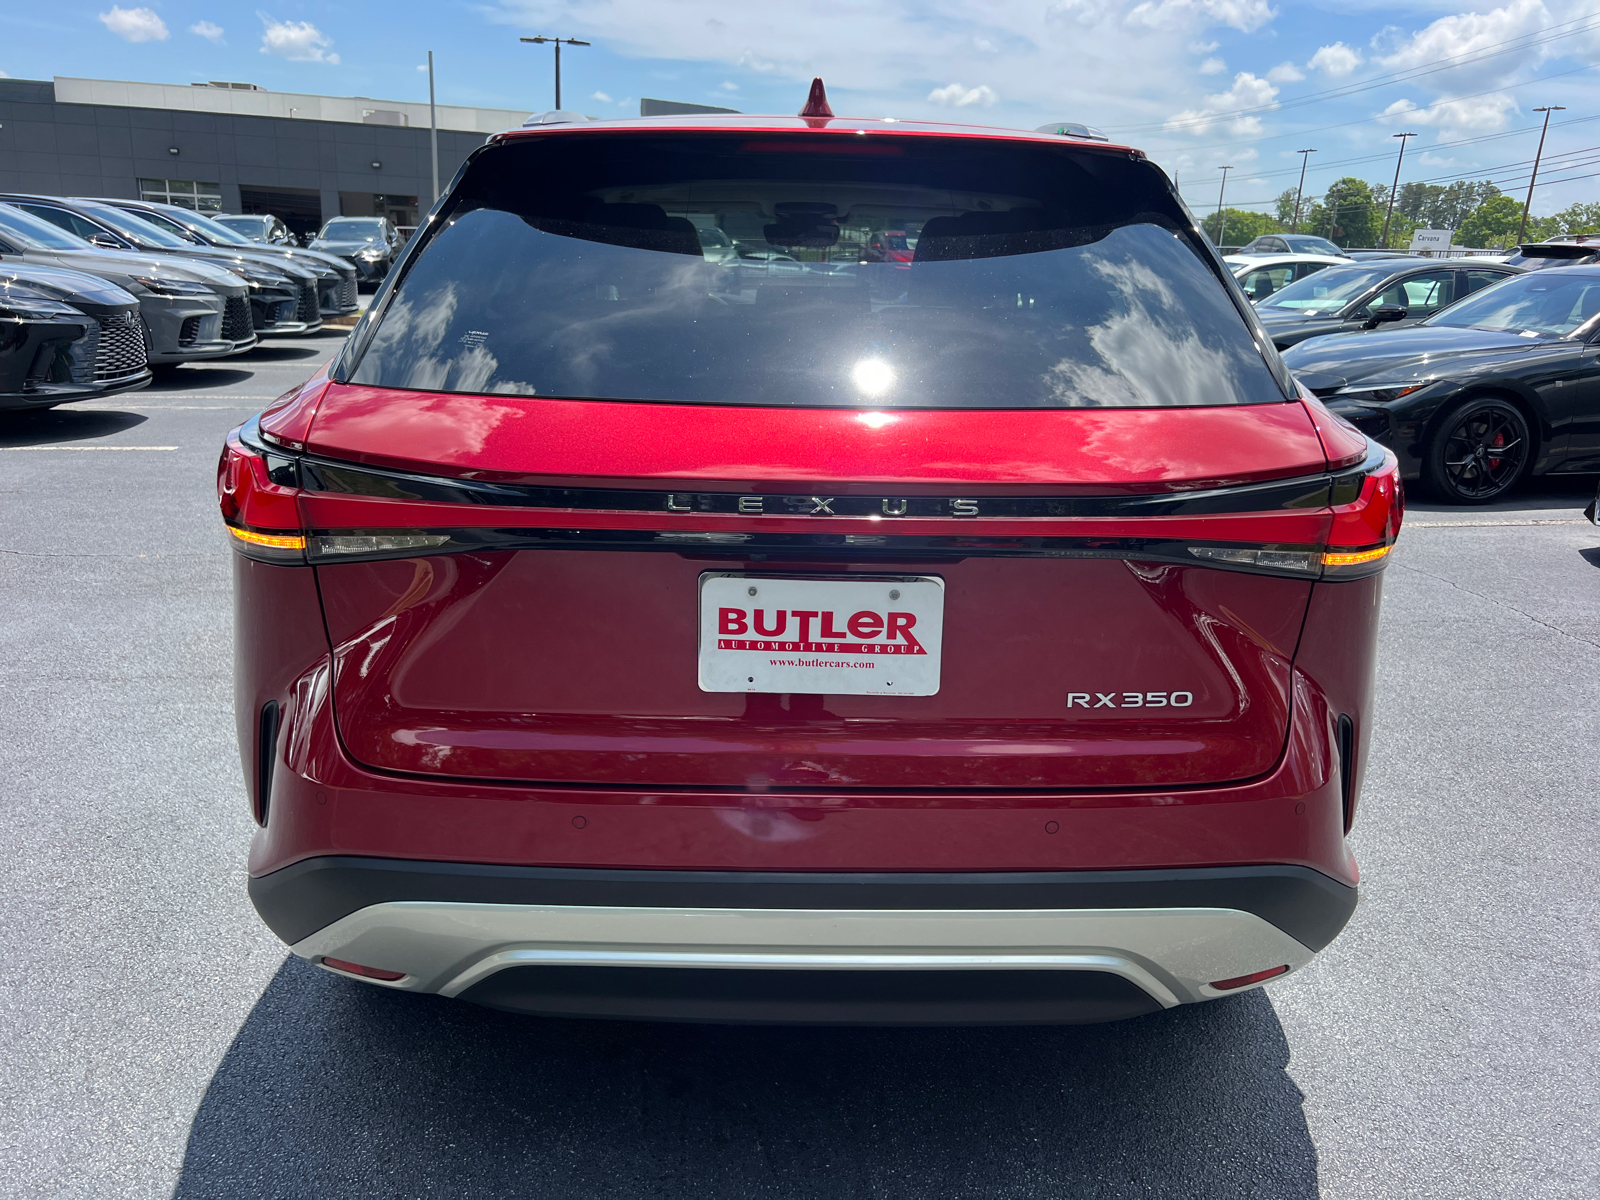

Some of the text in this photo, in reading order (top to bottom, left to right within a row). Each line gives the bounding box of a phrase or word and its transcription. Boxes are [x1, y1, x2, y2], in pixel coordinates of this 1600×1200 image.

[1417, 234, 1440, 242] Carvana
[667, 494, 979, 516] LEXUS
[719, 640, 920, 654] AUTOMOTIVE GROUP
[769, 658, 875, 669] www.butlercars.com
